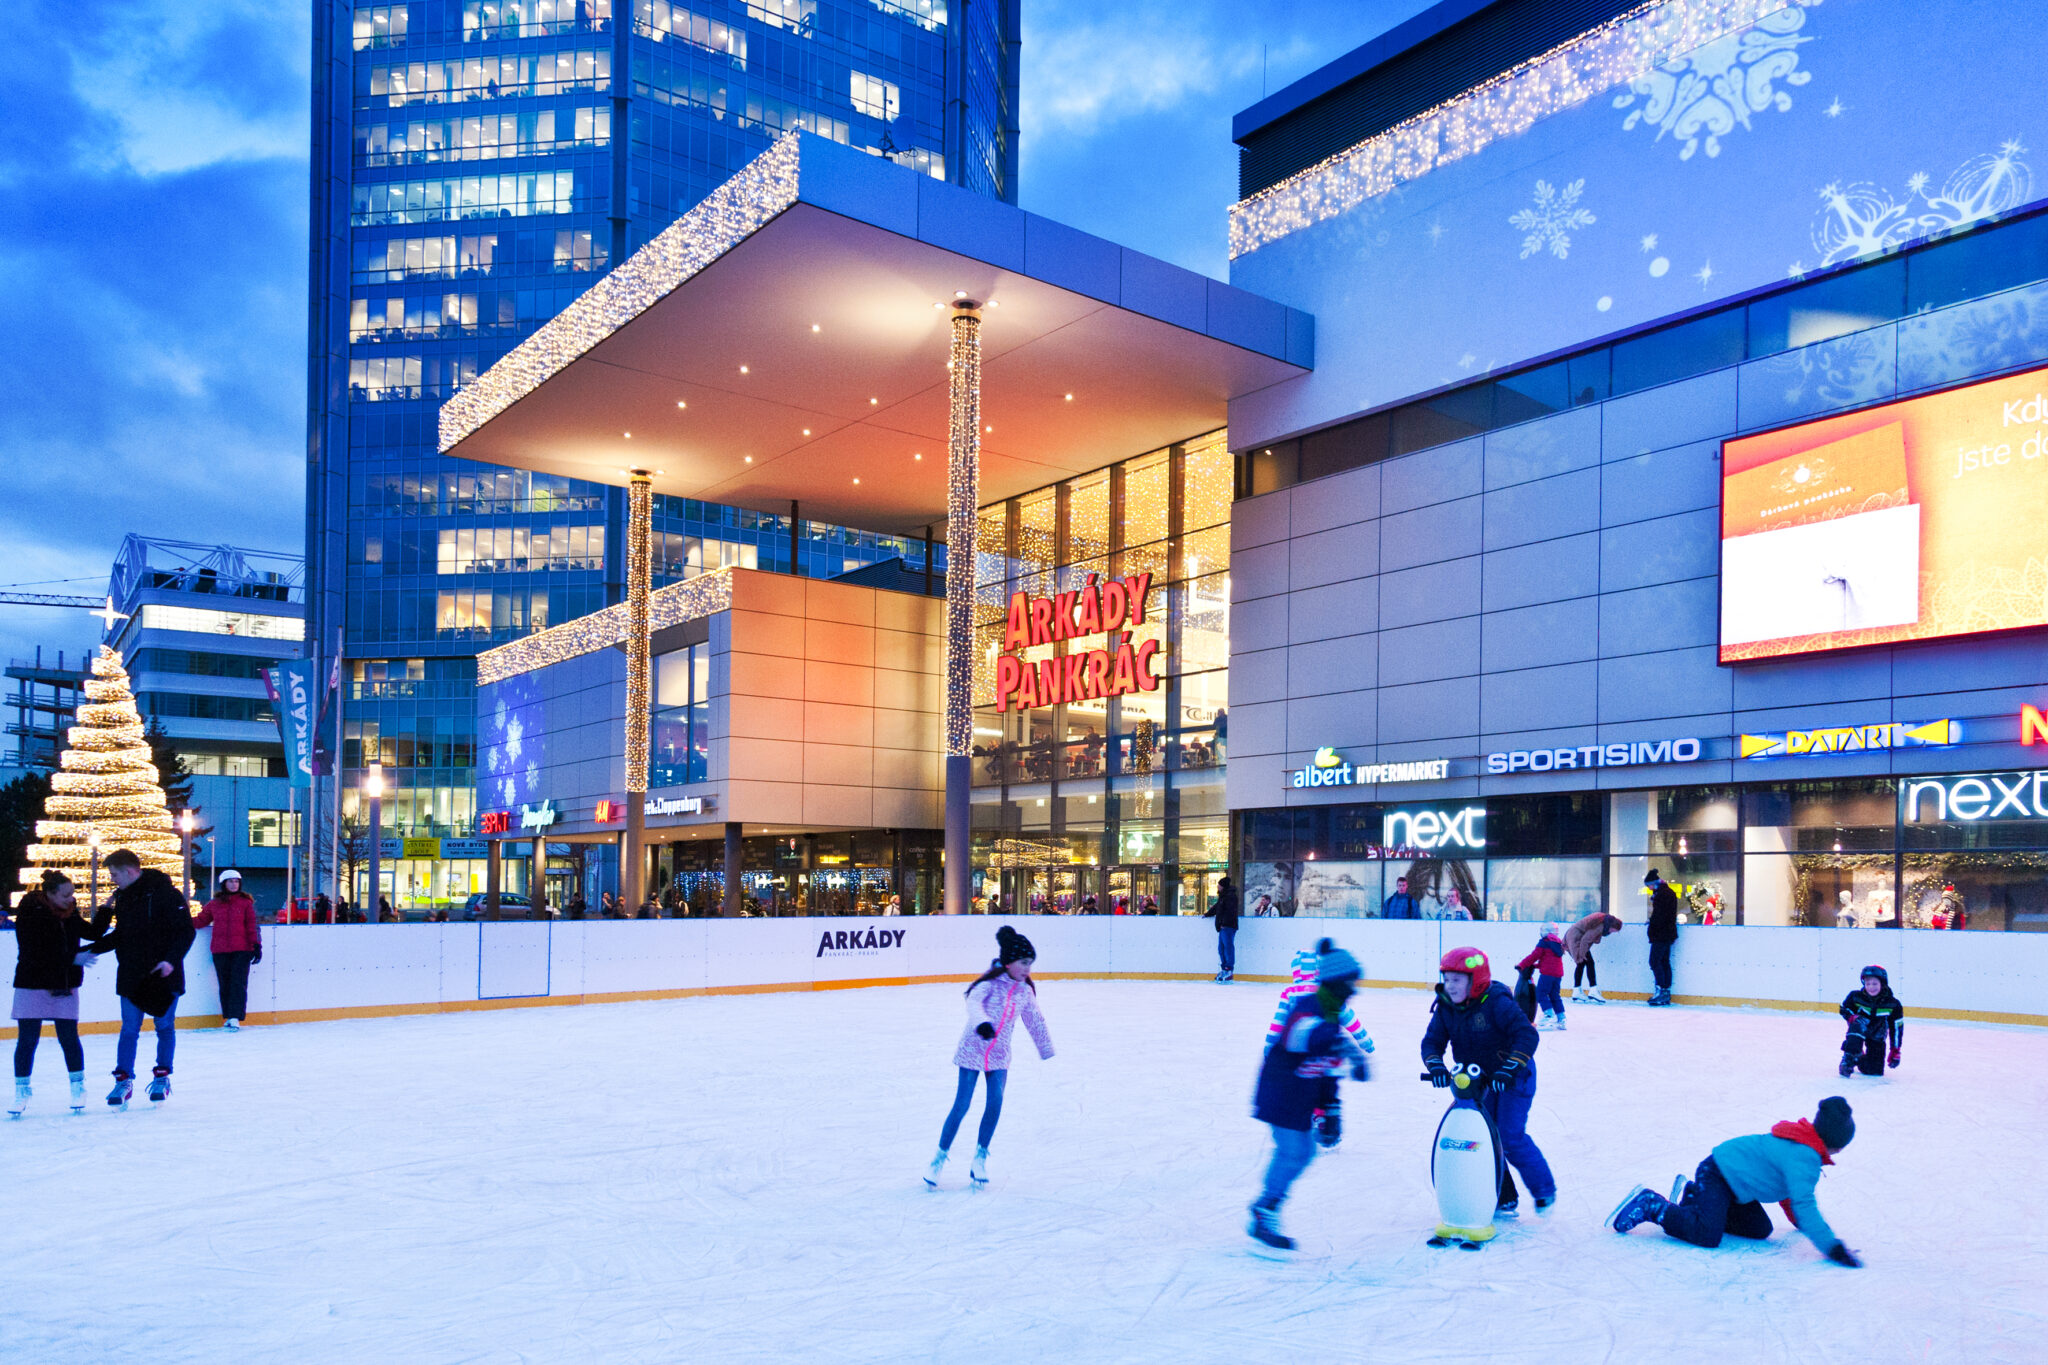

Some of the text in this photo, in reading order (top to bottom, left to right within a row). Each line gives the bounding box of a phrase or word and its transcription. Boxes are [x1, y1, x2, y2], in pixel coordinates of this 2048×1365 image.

[1953, 447, 2011, 479] jste
[1004, 573, 1152, 651] ARKÁDY
[996, 630, 1159, 712] PANKRÁC
[289, 670, 312, 775] ARKÁDY
[1787, 723, 1902, 753] DATART
[1293, 760, 1449, 788] albert HYPERMARKET
[1487, 738, 1700, 774] SPORTISIMO
[1384, 807, 1487, 848] next
[816, 926, 906, 957] ARKÁDY
